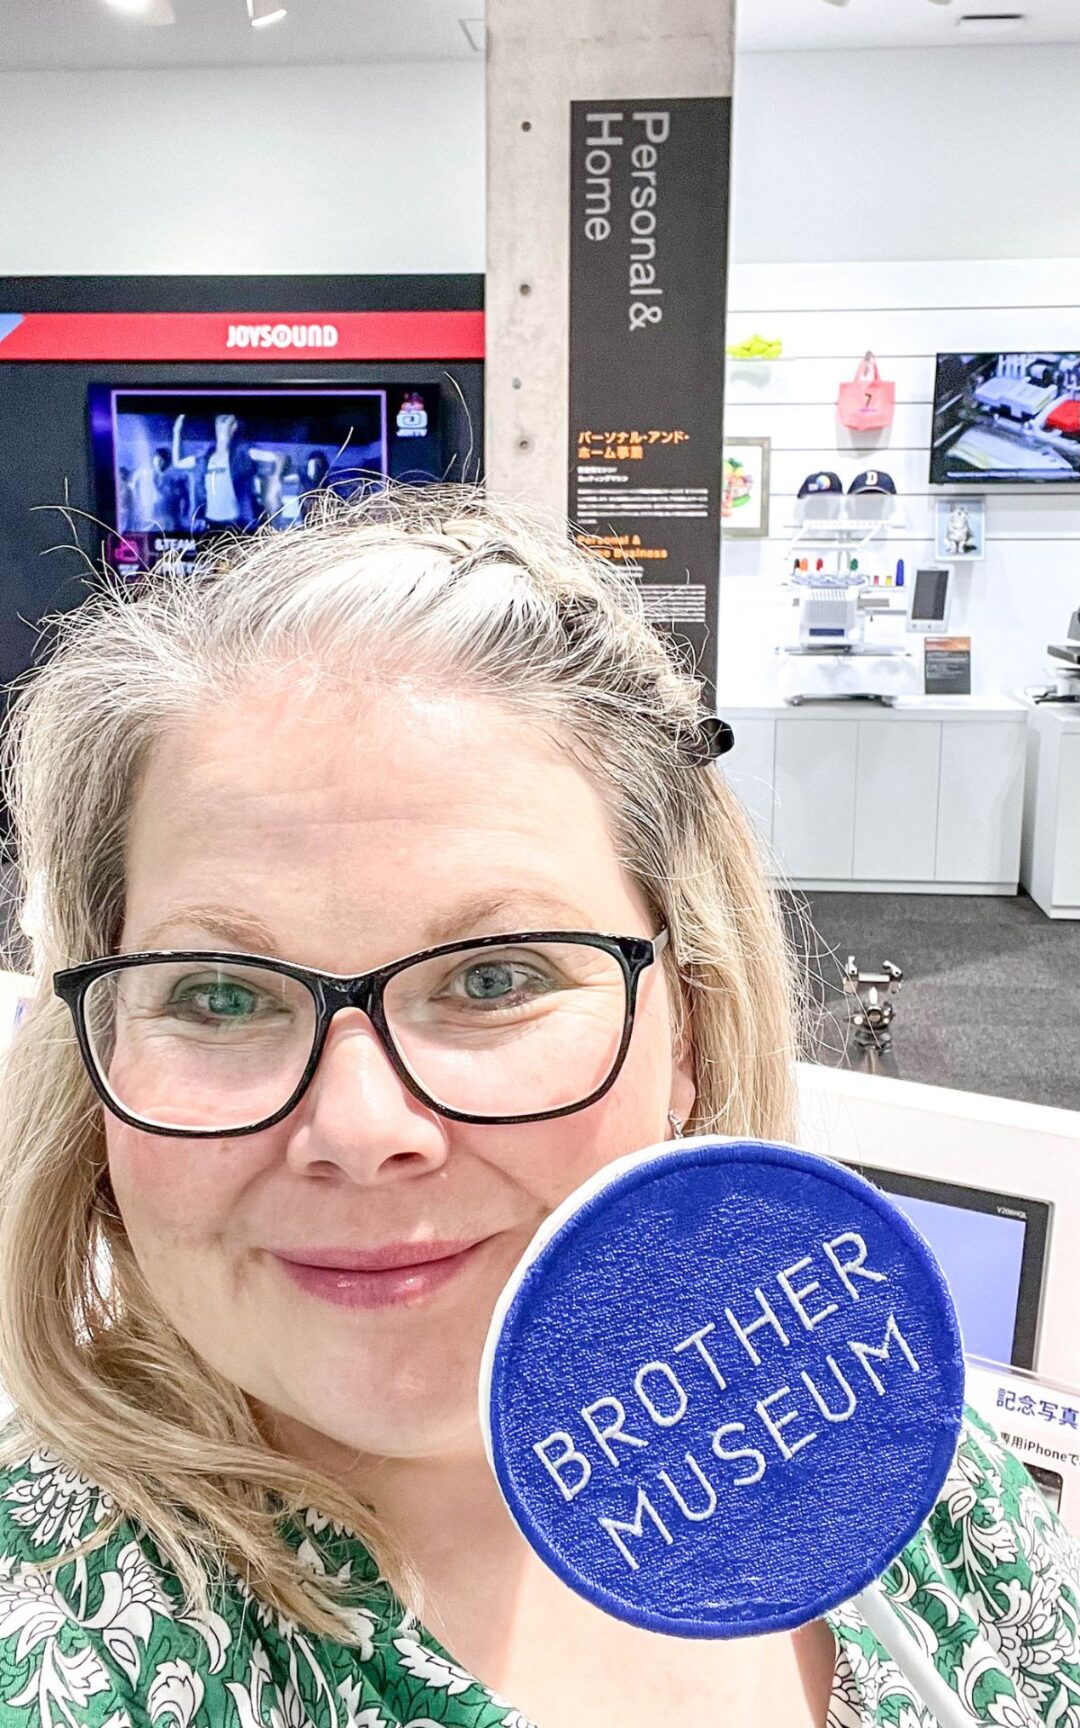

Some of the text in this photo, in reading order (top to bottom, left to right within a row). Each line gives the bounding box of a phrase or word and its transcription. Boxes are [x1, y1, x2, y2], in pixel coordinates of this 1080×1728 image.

[585, 113, 623, 241] Home
[629, 112, 670, 331] Personal &
[226, 324, 339, 348] JOYSOUND
[532, 1231, 887, 1502] BROTHER
[598, 1312, 920, 1571] MUSEUM
[996, 1387, 1080, 1431] 記念写真
